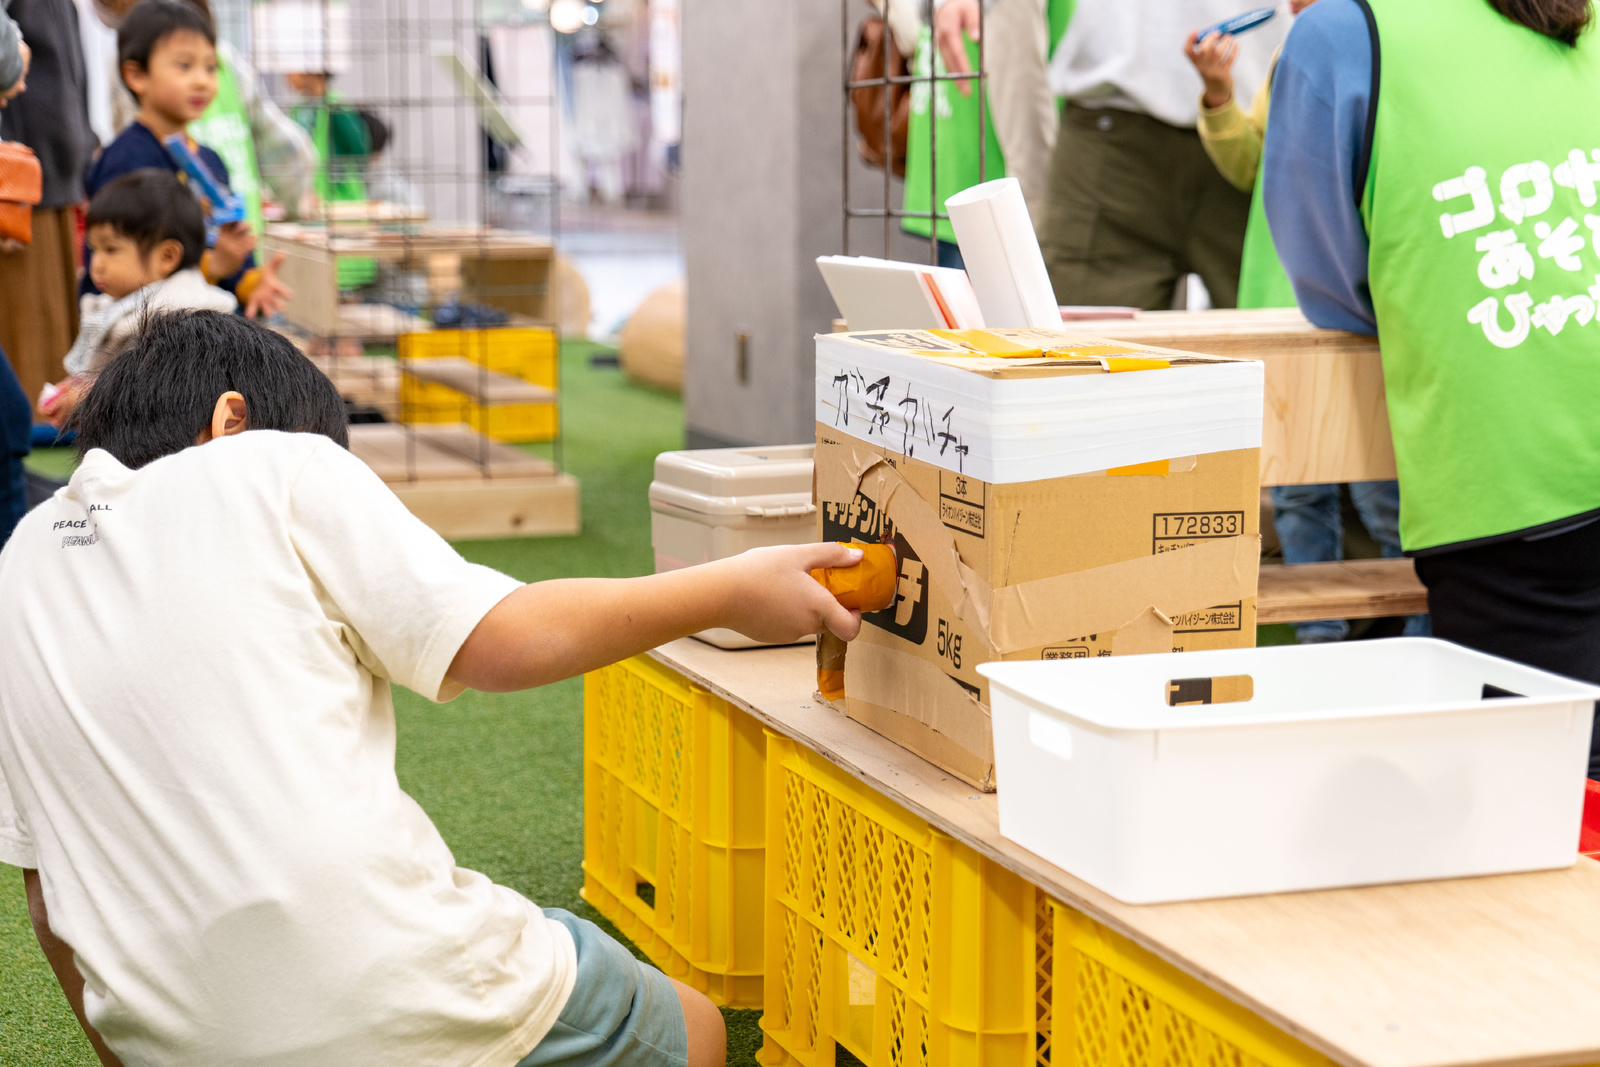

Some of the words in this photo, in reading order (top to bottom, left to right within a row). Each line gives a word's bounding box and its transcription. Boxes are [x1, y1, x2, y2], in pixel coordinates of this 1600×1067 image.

[1467, 274, 1600, 349] ひゃっ
[955, 477, 967, 498] 3本
[53, 519, 88, 531] PEACE
[89, 504, 113, 514] ALL
[1162, 514, 1238, 536] 172833
[937, 617, 962, 670] 5kg
